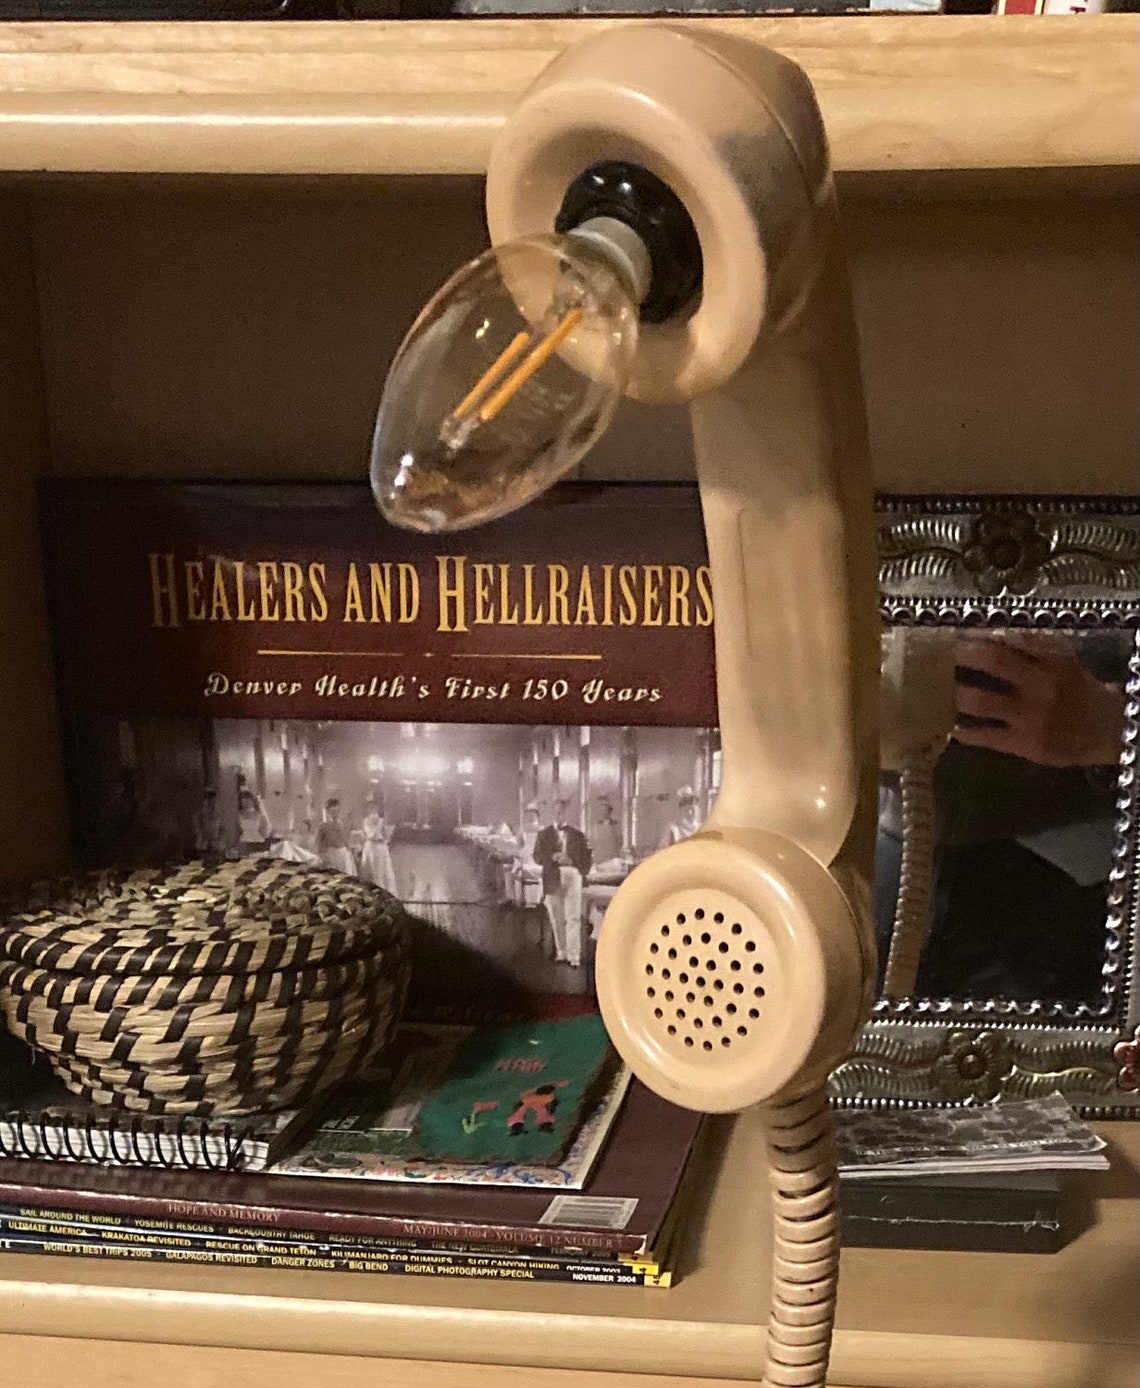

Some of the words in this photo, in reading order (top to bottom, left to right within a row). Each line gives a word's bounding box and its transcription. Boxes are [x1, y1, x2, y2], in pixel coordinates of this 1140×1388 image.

[149, 553, 328, 627] HEALERS
[343, 563, 419, 623] AND
[436, 556, 714, 632] HELLRAISERS
[204, 672, 302, 697] Denver
[315, 674, 430, 698] Health's
[446, 677, 511, 699] First
[523, 679, 568, 699] 150
[582, 679, 662, 704] Years
[20, 1208, 37, 1218] SAIL
[40, 1210, 72, 1221] AROUND
[75, 1212, 90, 1222] THE
[92, 1214, 121, 1225] WORLD
[169, 1204, 198, 1216] HOPE
[202, 1206, 226, 1218] AND
[229, 1209, 281, 1222] MEMORY
[9, 1221, 46, 1233] ULTIMATE
[50, 1224, 87, 1236] AMERICA
[177, 1221, 214, 1233] RESCUES
[148, 1235, 191, 1246] REVISITED
[206, 1240, 239, 1251] RESCUE
[242, 1242, 255, 1252] ON
[43, 1242, 81, 1254] WORLD'S
[83, 1245, 103, 1255] BEST
[106, 1246, 128, 1257] TRIPS
[271, 1255, 304, 1267] DANGER
[307, 1258, 334, 1269] ZONES
[348, 1260, 363, 1270] BIG
[364, 1261, 388, 1272] BEND
[404, 1262, 434, 1274] DIGITAL
[437, 1263, 497, 1278] PHOTOGRAPHY
[500, 1267, 534, 1279] SPECIAL
[572, 1272, 613, 1284] NOVEMBER
[617, 1275, 636, 1285] 2004
